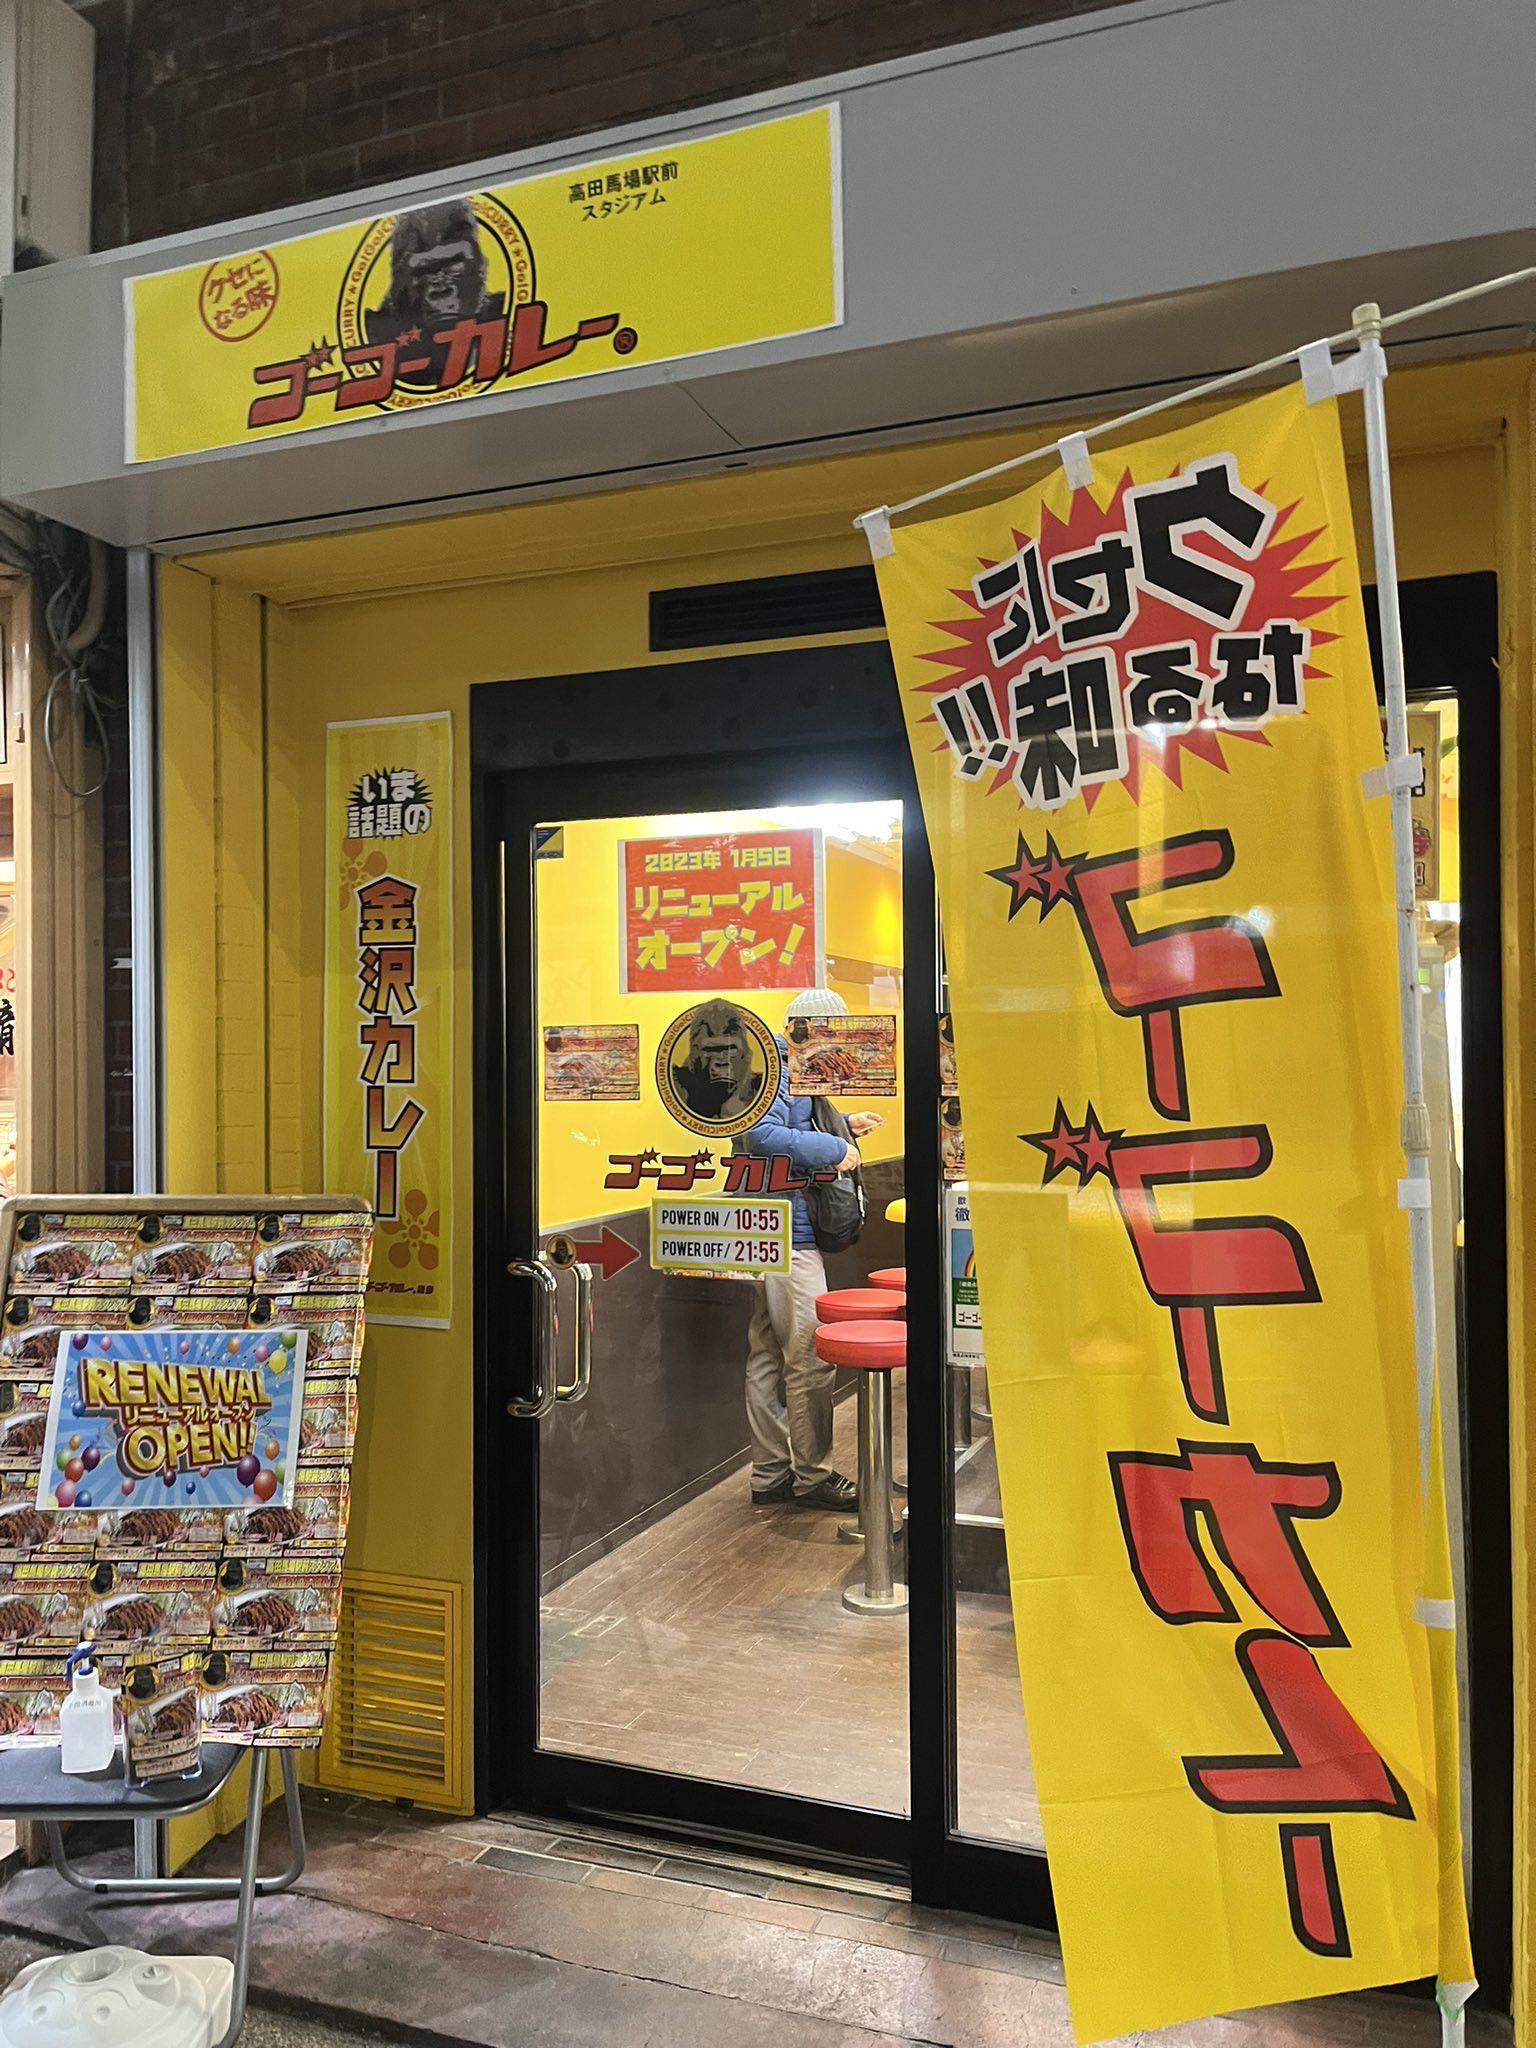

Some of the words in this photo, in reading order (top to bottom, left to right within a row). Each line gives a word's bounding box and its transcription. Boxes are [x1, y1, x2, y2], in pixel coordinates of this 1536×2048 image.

[568, 161, 679, 203] 高田馬場駅前
[581, 188, 667, 222] スタジアム
[207, 258, 265, 304] クセに
[213, 280, 276, 330] なる味
[361, 770, 416, 803] いま
[348, 804, 432, 838] 話題の
[645, 851, 721, 873] 2023年
[730, 846, 791, 868] 1月5日
[634, 880, 806, 921] リニューアル
[634, 923, 806, 970] オープン!
[355, 875, 425, 1221] 金沢カレー
[604, 1147, 838, 1193] ゴーゴーカレー
[662, 1210, 701, 1227] POWER
[704, 1211, 719, 1227] ON
[735, 1209, 779, 1231] 10:55
[662, 1241, 701, 1257] POWER
[735, 1240, 779, 1262] 21:55
[84, 1359, 272, 1407] RENEWAL
[124, 1405, 255, 1425] リニューアルオープン
[126, 1422, 256, 1472] OPEN!!
